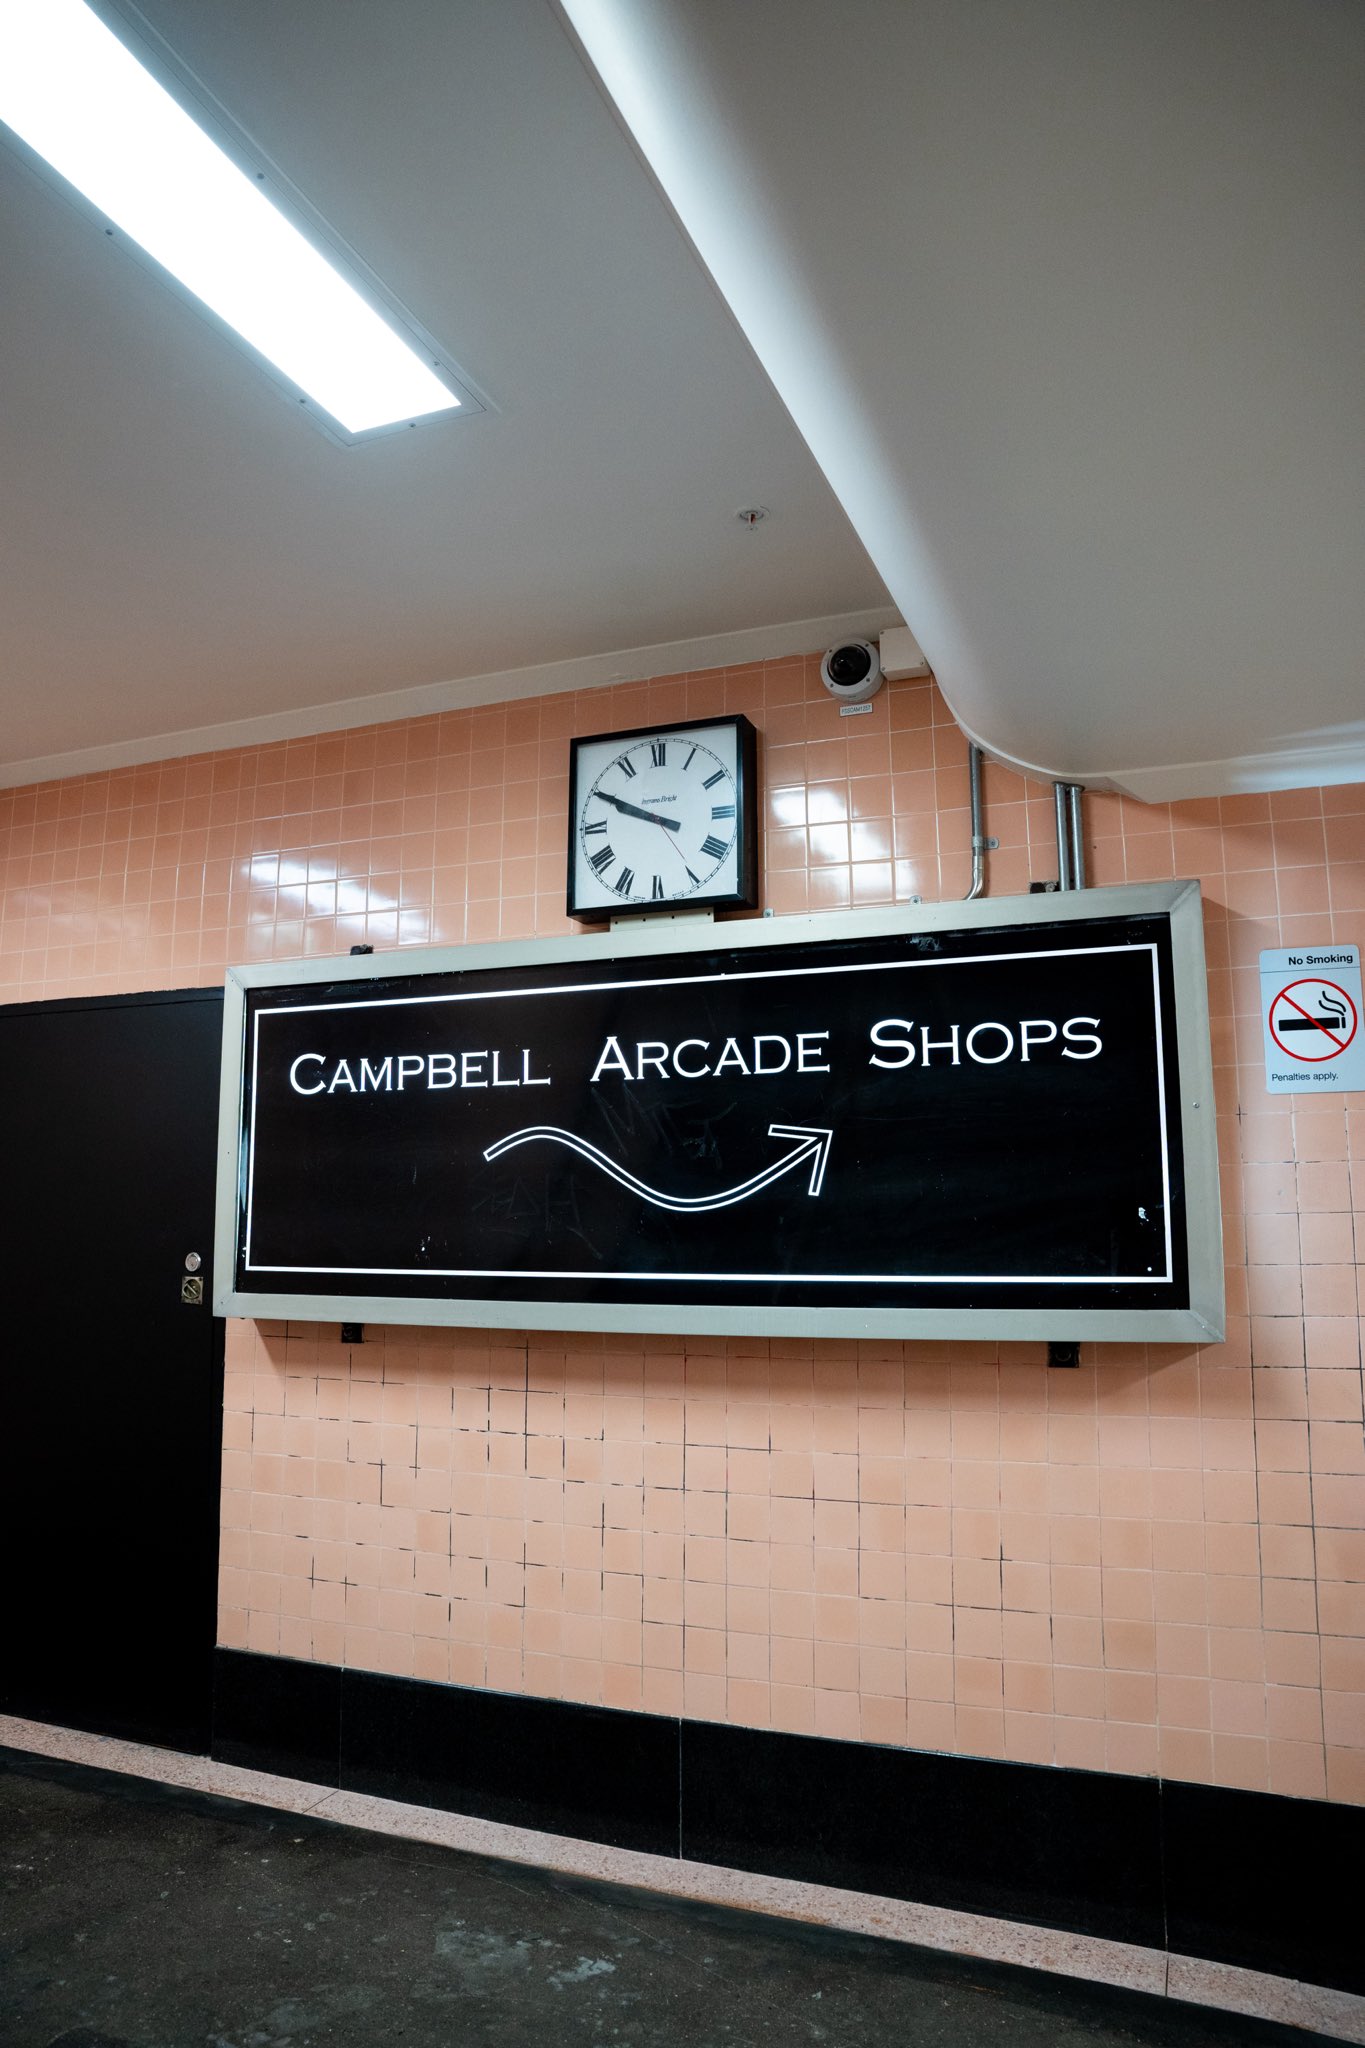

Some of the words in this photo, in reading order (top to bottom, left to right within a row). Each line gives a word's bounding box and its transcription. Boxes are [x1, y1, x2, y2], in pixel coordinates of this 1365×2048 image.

[650, 742, 668, 768] XII
[681, 747, 697, 772] I
[616, 756, 639, 783] XI
[701, 769, 726, 792] II
[711, 804, 735, 820] III
[589, 844, 616, 875] VIII
[614, 866, 635, 896] VII
[651, 875, 665, 900] VI
[685, 865, 701, 887] V
[1288, 956, 1303, 966] No
[1306, 954, 1353, 964] Smoking
[289, 1048, 551, 1096] CAMPBELL
[589, 1030, 831, 1082] ARCADE
[868, 1016, 1104, 1069] SHOPS
[1272, 1072, 1310, 1082] Penalties
[1313, 1072, 1339, 1081] apply.
